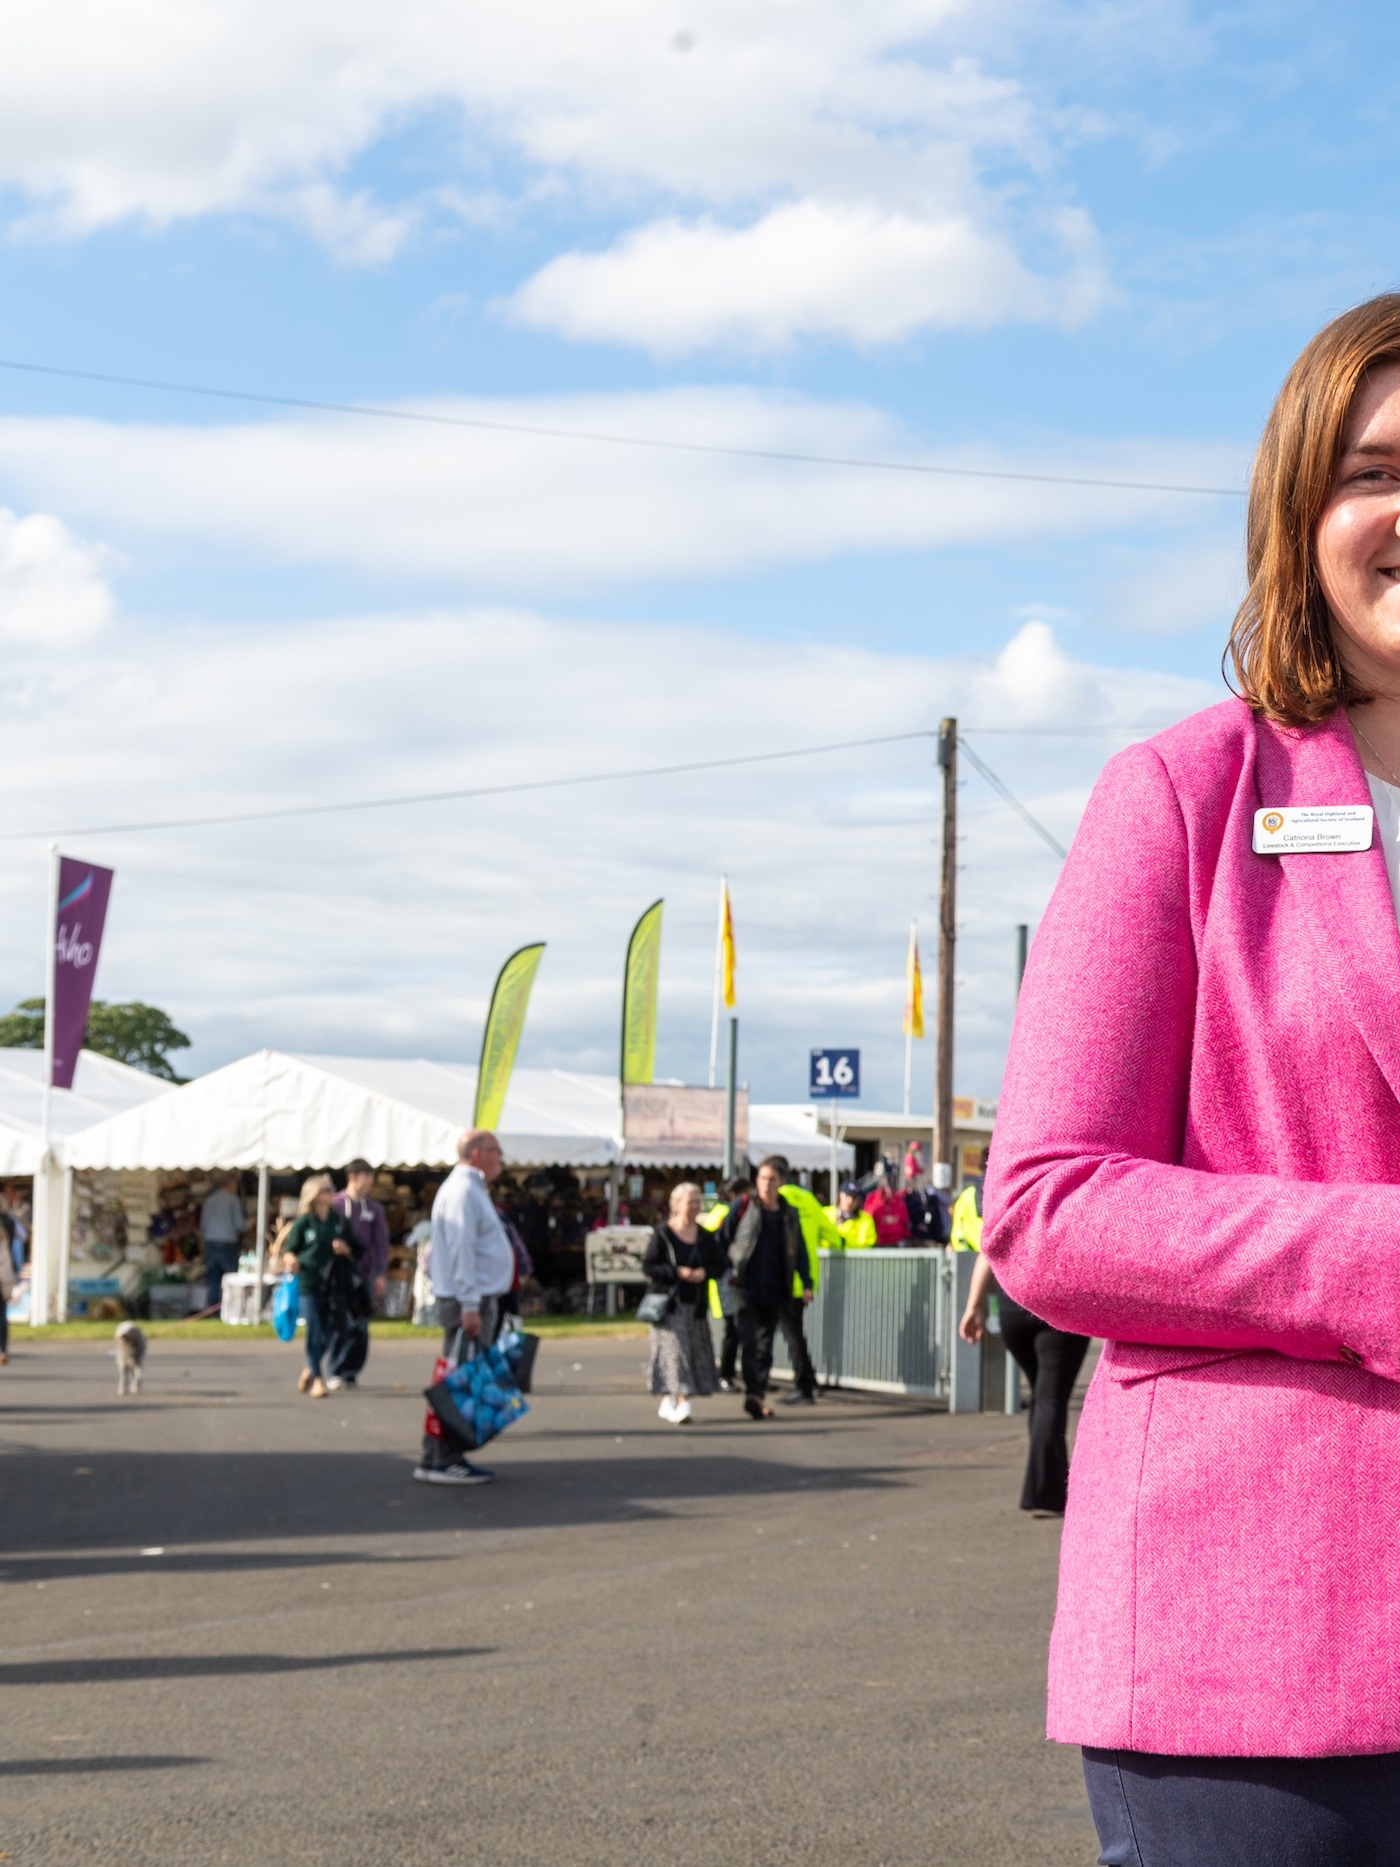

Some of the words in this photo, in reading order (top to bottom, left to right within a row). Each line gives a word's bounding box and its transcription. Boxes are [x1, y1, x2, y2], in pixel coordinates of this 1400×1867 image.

[1283, 834, 1315, 842] Catriona
[1317, 833, 1341, 841] Brown
[1295, 841, 1332, 849] Competitions
[816, 1056, 854, 1086] 16
